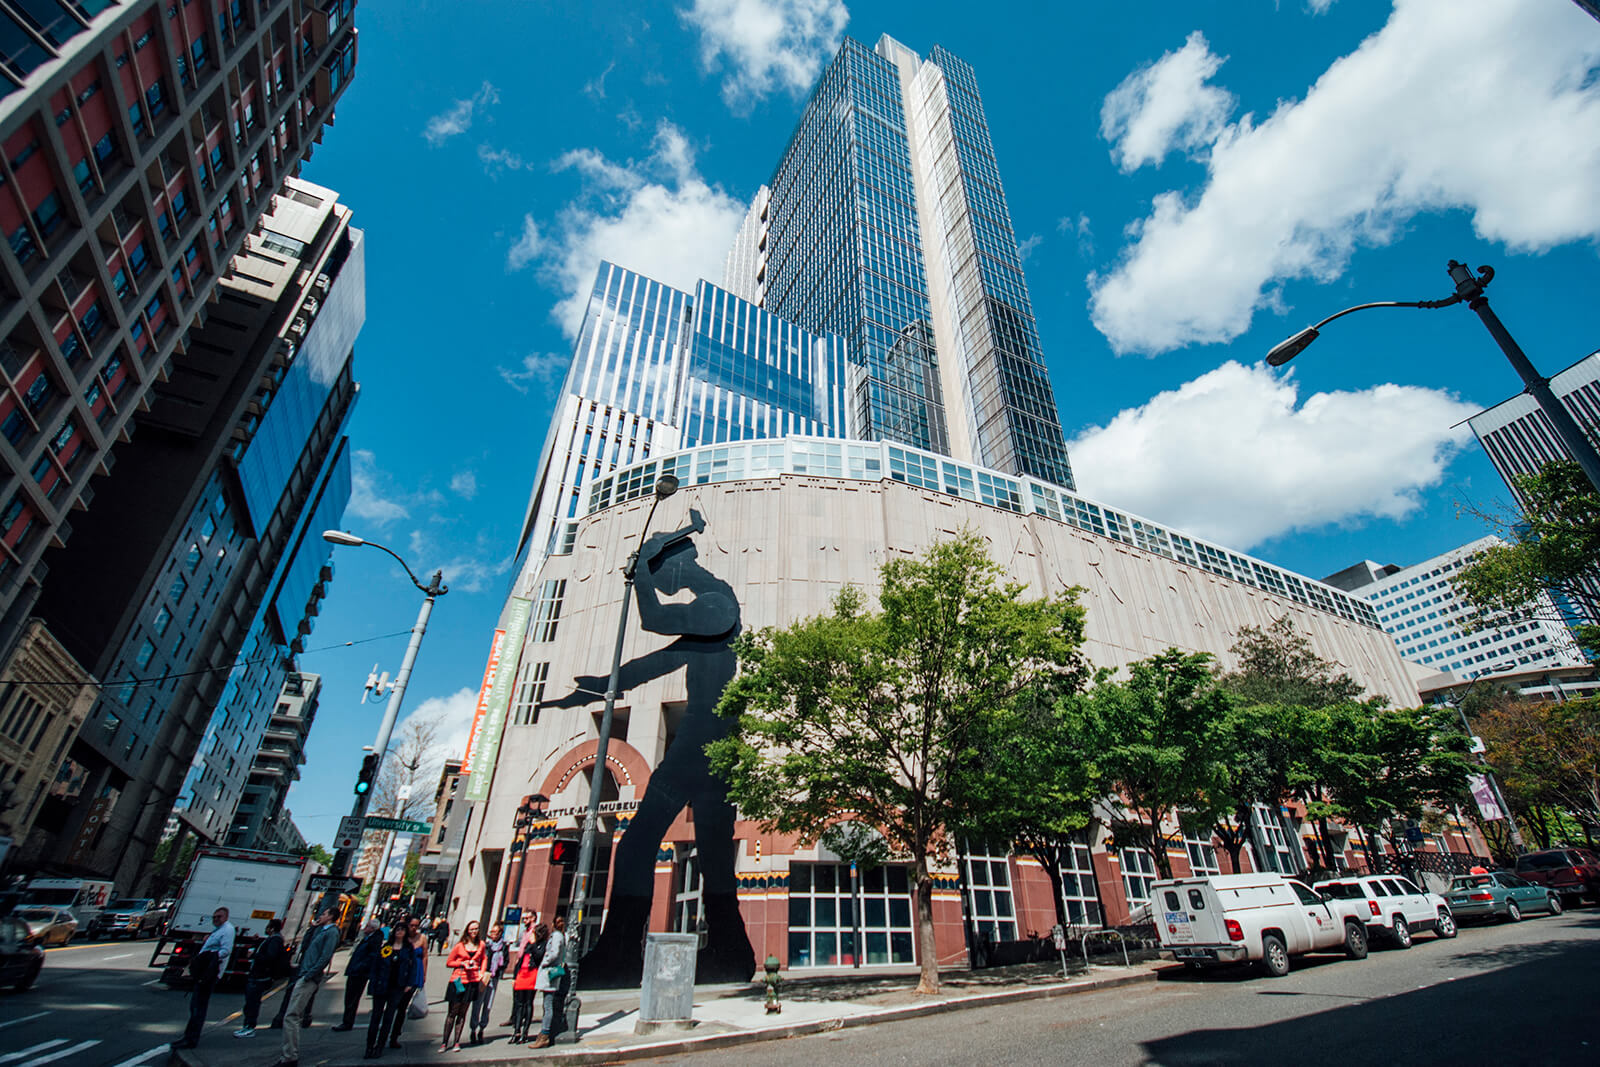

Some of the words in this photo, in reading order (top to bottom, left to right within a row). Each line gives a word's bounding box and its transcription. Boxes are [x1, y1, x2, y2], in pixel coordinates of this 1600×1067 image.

[479, 687, 493, 711] ART
[465, 714, 486, 771] MUSEUM
[368, 817, 410, 831] University
